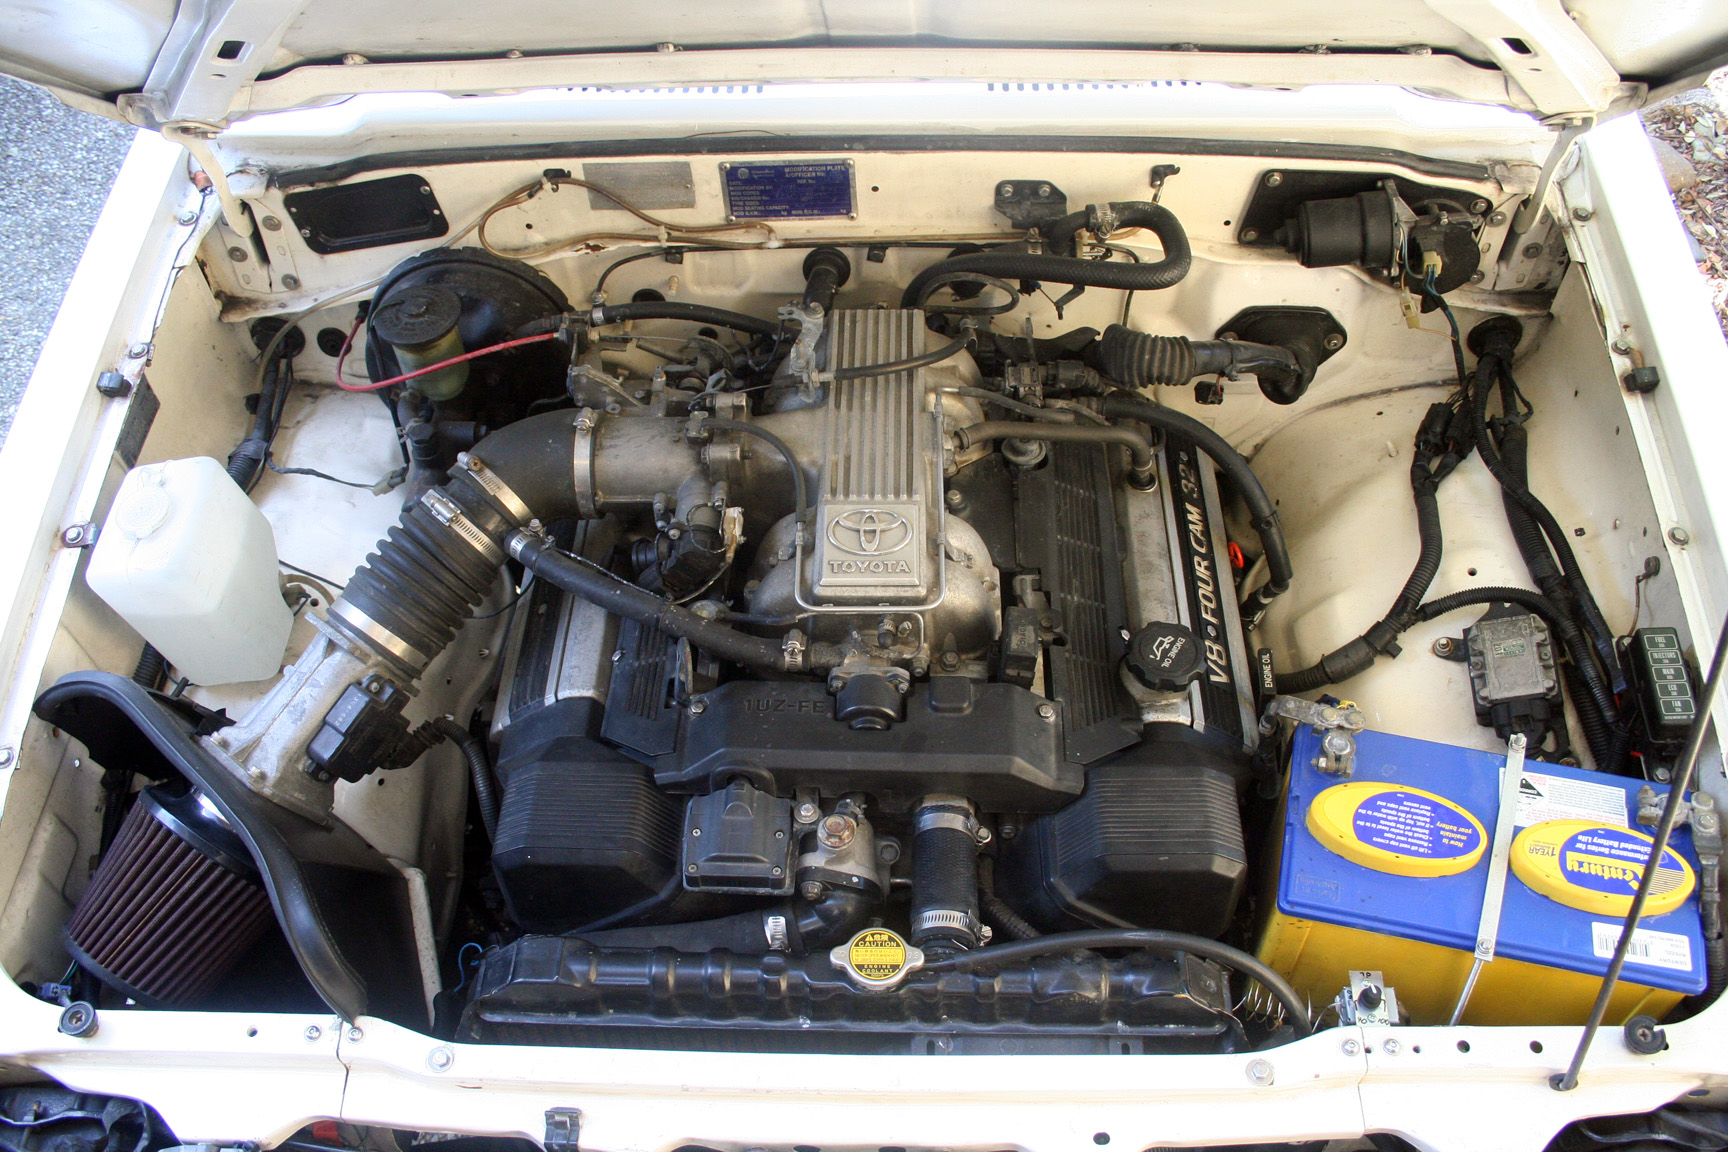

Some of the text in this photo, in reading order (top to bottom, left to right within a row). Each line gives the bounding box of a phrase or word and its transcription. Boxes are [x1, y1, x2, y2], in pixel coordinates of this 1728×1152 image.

[829, 560, 911, 573] TOYOTA
[1181, 464, 1230, 683] V8 FOUR CAM 32
[1160, 637, 1186, 668] ENGINE OIL
[1261, 653, 1273, 688] ENGINE OIL
[744, 698, 824, 713] 1UZ-FE
[1387, 802, 1399, 810] caps
[1372, 811, 1387, 819] water
[1411, 807, 1431, 816] Replace
[1387, 815, 1398, 823] with
[1412, 814, 1430, 823] bottom
[1377, 824, 1389, 832] level
[1411, 826, 1429, 834] bottom
[1436, 821, 1458, 832] battery
[1413, 832, 1429, 840] Check
[1440, 830, 1467, 841] maintain
[1577, 834, 1592, 843] Life
[1372, 837, 1389, 845] covers
[1408, 838, 1429, 847] Remove
[1450, 840, 1464, 848] How
[1592, 836, 1619, 848] Battery
[1575, 842, 1586, 850] for
[1587, 844, 1610, 855] Series
[1528, 846, 1551, 857] YEAR
[1550, 847, 1556, 857] 1
[1659, 957, 1687, 966] CENTURY
